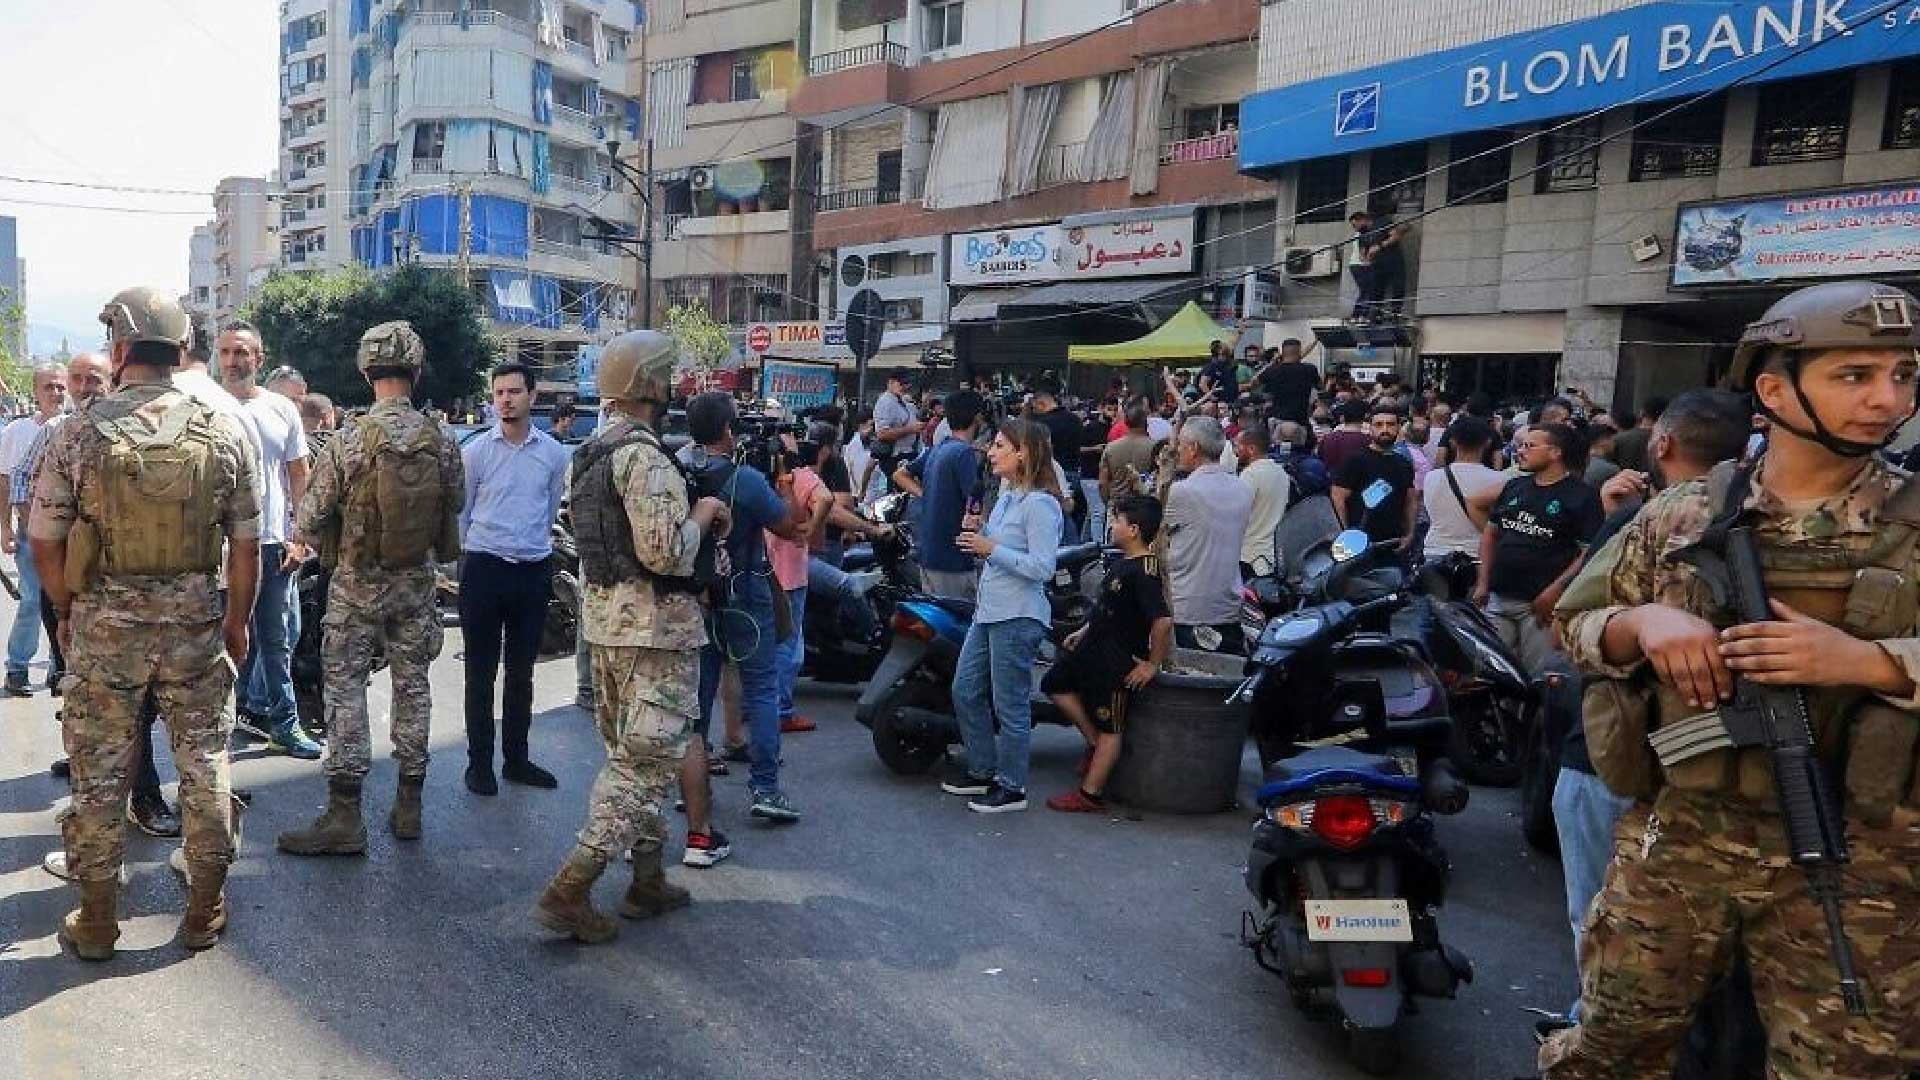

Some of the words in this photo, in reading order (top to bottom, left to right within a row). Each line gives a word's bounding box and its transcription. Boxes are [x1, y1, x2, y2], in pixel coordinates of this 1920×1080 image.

[1465, 34, 1630, 107] BLOM
[1659, 0, 1853, 72] BANK
[1077, 239, 1183, 272] دعبول
[777, 325, 822, 342] TIMA
